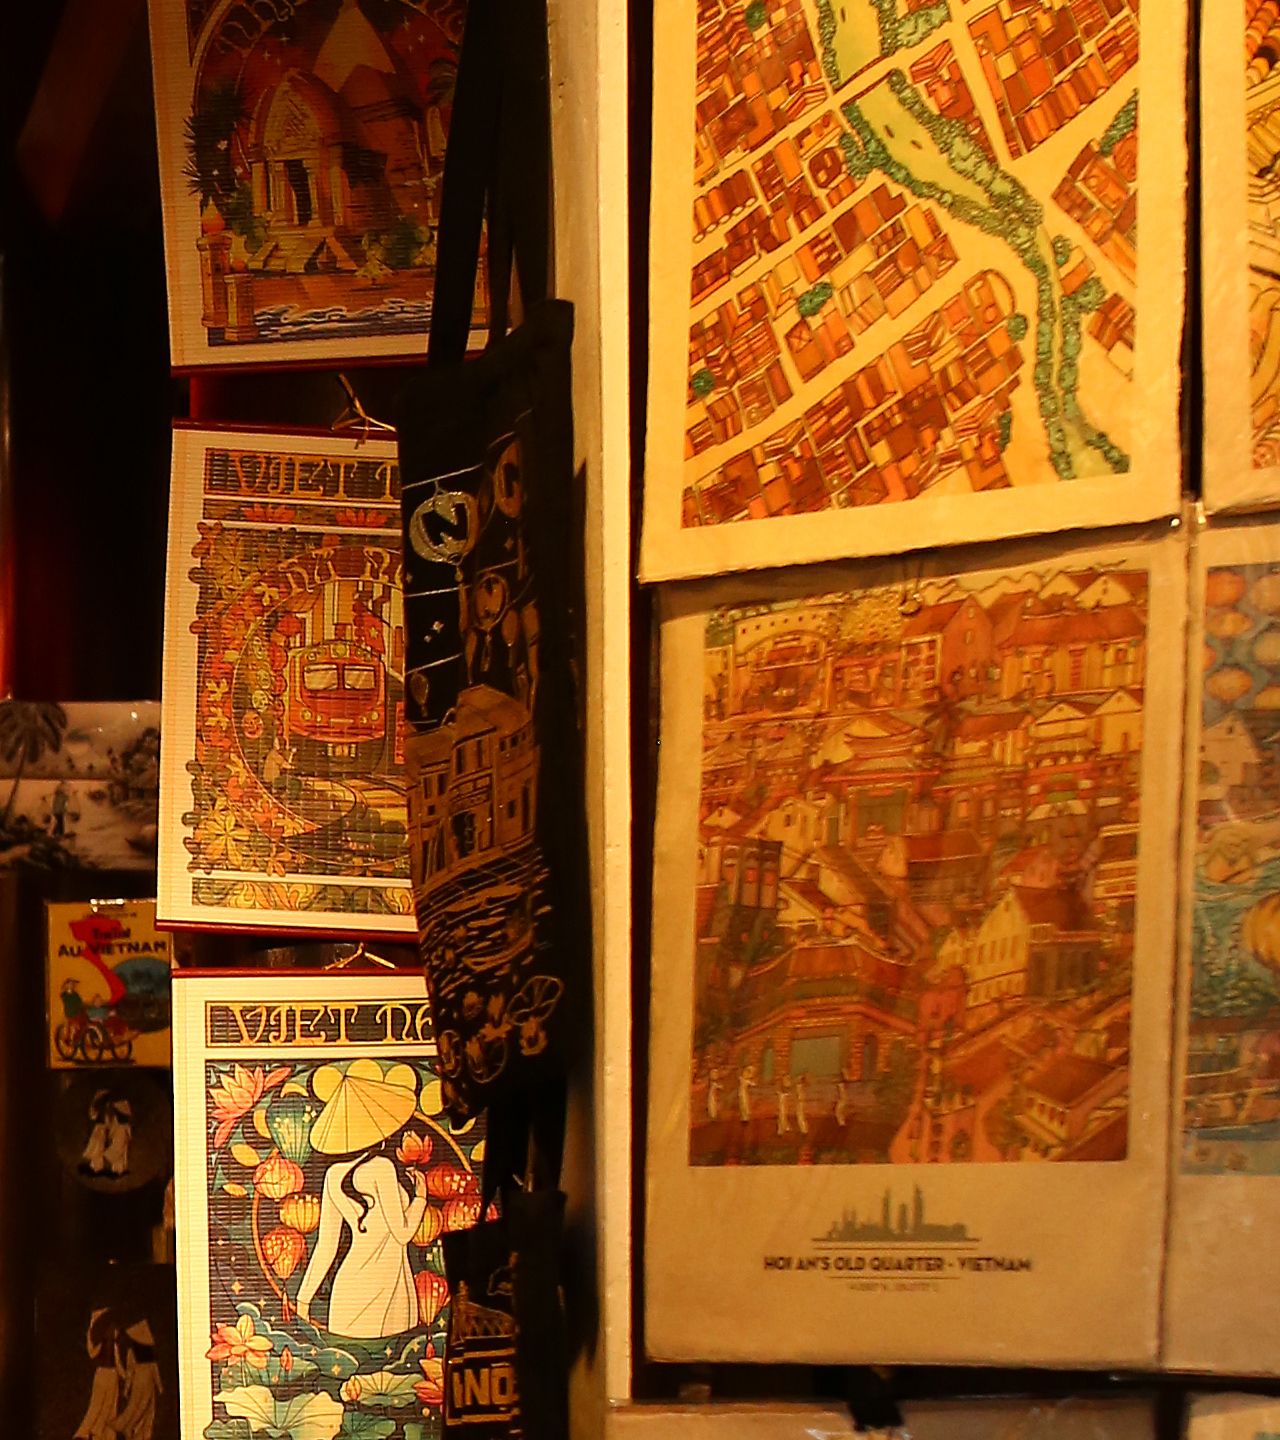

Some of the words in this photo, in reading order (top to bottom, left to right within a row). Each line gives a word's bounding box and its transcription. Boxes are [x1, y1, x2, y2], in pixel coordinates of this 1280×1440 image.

[226, 450, 358, 501] VIET
[58, 943, 82, 958] AU
[90, 940, 167, 956] VIETNAM
[229, 1003, 359, 1046] VIET
[763, 1256, 793, 1271] HOI
[833, 1256, 865, 1271] OLD
[870, 1256, 944, 1271] QUARTER
[956, 1257, 1033, 1272] VIETNAM
